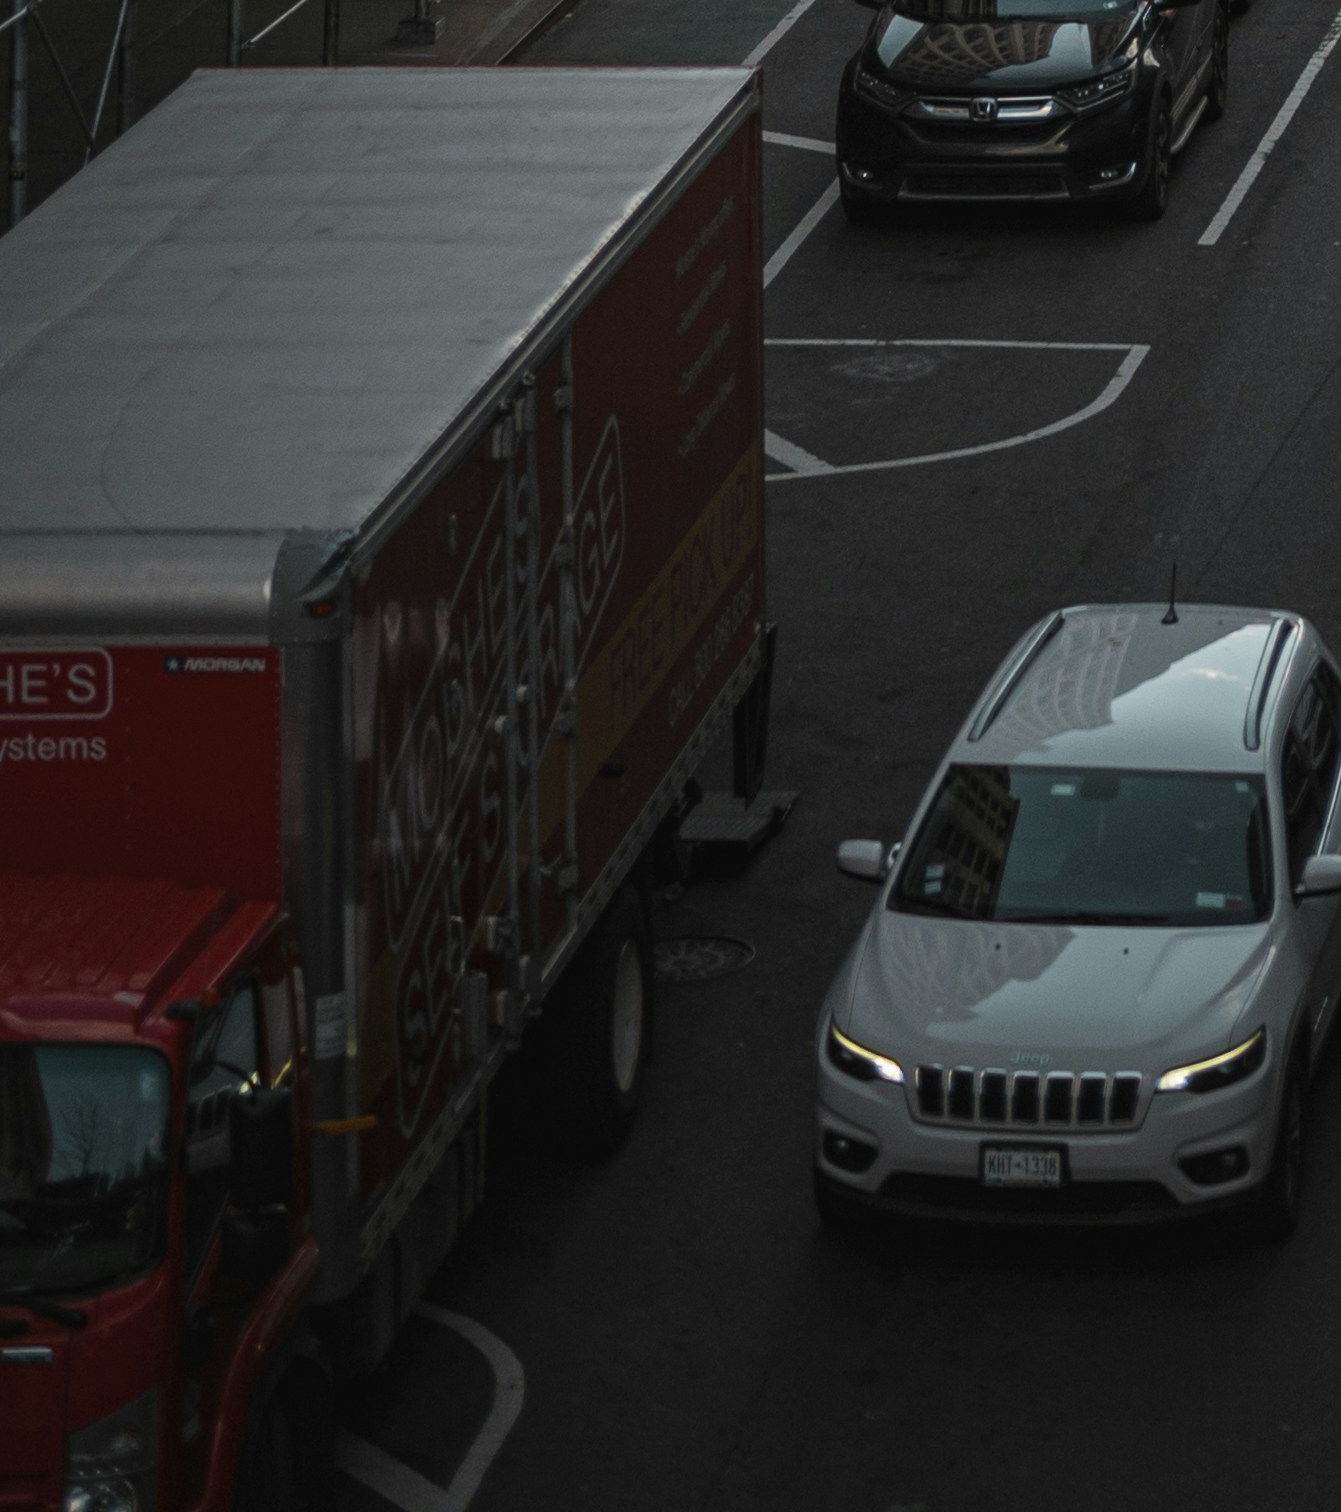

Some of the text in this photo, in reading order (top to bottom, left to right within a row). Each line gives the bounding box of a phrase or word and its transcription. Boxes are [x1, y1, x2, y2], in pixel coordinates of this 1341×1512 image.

[609, 604, 664, 731] FREE
[669, 537, 719, 641] PICK
[183, 656, 267, 673] MORGAN
[1010, 1050, 1051, 1066] Jeep
